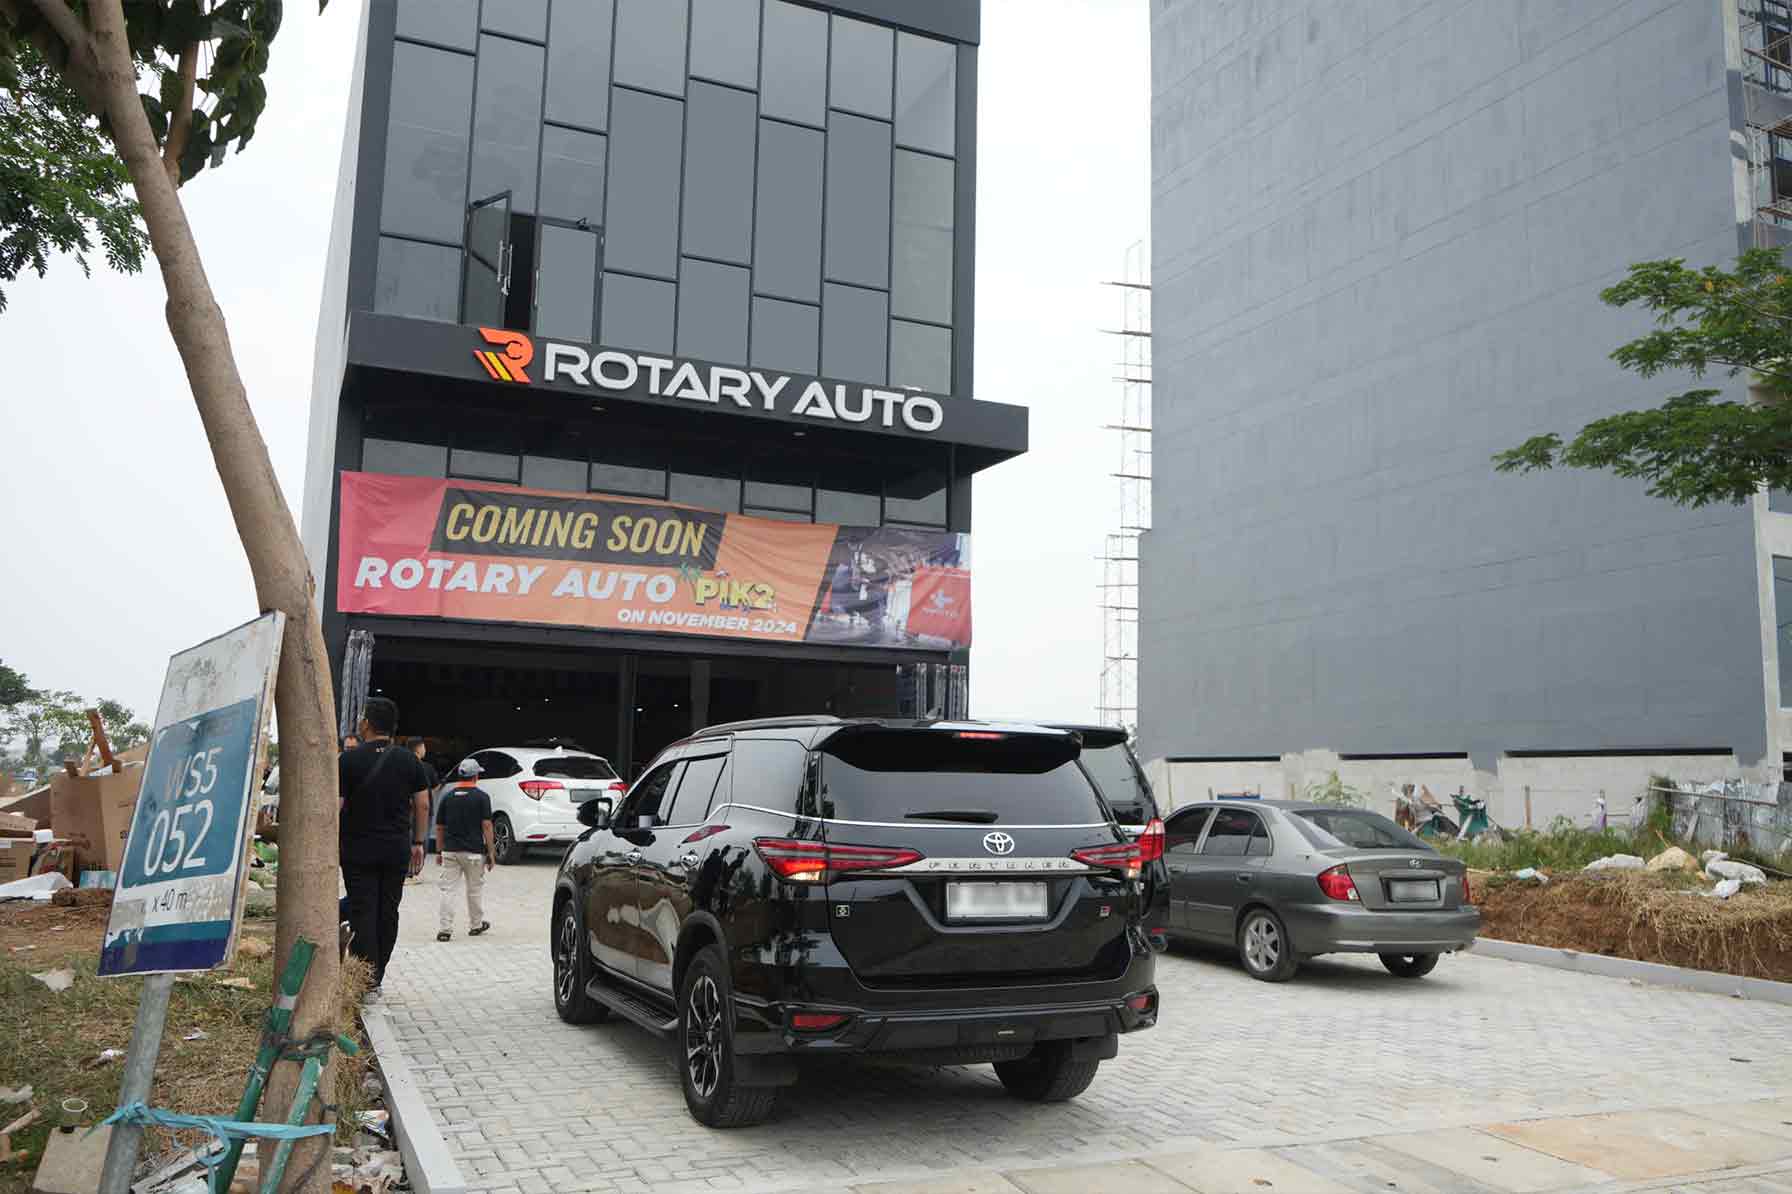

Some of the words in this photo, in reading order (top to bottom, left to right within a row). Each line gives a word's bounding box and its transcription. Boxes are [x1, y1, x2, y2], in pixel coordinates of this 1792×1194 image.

[543, 343, 790, 411] ROTARY
[793, 381, 944, 432] AUTO
[446, 503, 599, 549] COMING
[607, 515, 707, 557] SOON
[354, 556, 546, 597] ROTARY
[552, 569, 676, 604] AUTO
[695, 578, 776, 609] PIK2
[617, 608, 646, 624] ON
[649, 611, 749, 631] NOVEMBER
[752, 618, 797, 633] 2024
[143, 800, 214, 876] 052
